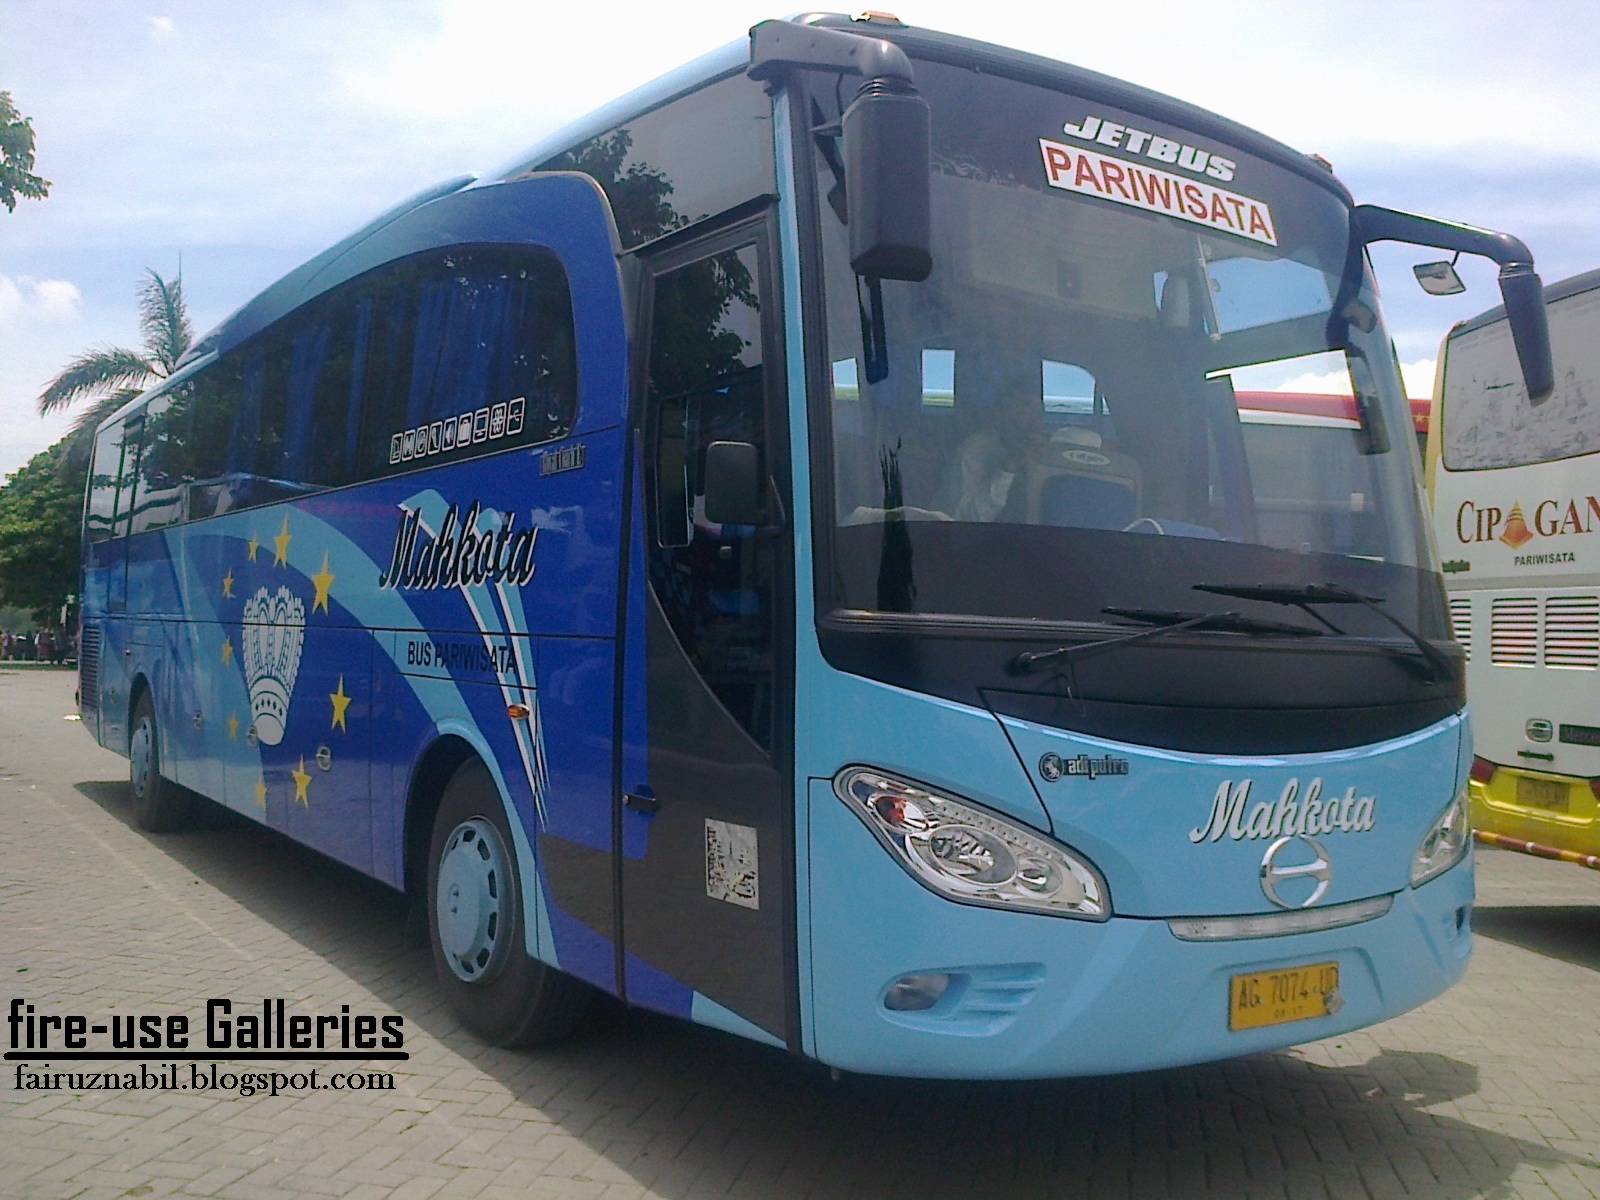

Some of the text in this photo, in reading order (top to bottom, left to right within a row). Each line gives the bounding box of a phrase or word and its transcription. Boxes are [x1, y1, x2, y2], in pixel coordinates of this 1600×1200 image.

[1063, 115, 1237, 182] JETBUS
[1046, 145, 1272, 240] PARIWISATA
[379, 500, 539, 590] Mahkota
[1514, 552, 1575, 566] PARIWISATA
[407, 641, 517, 674] BUS PARIWISATA
[1189, 777, 1376, 843] Mahkota
[1238, 978, 1262, 1010] AG
[1269, 971, 1309, 1005] 7074
